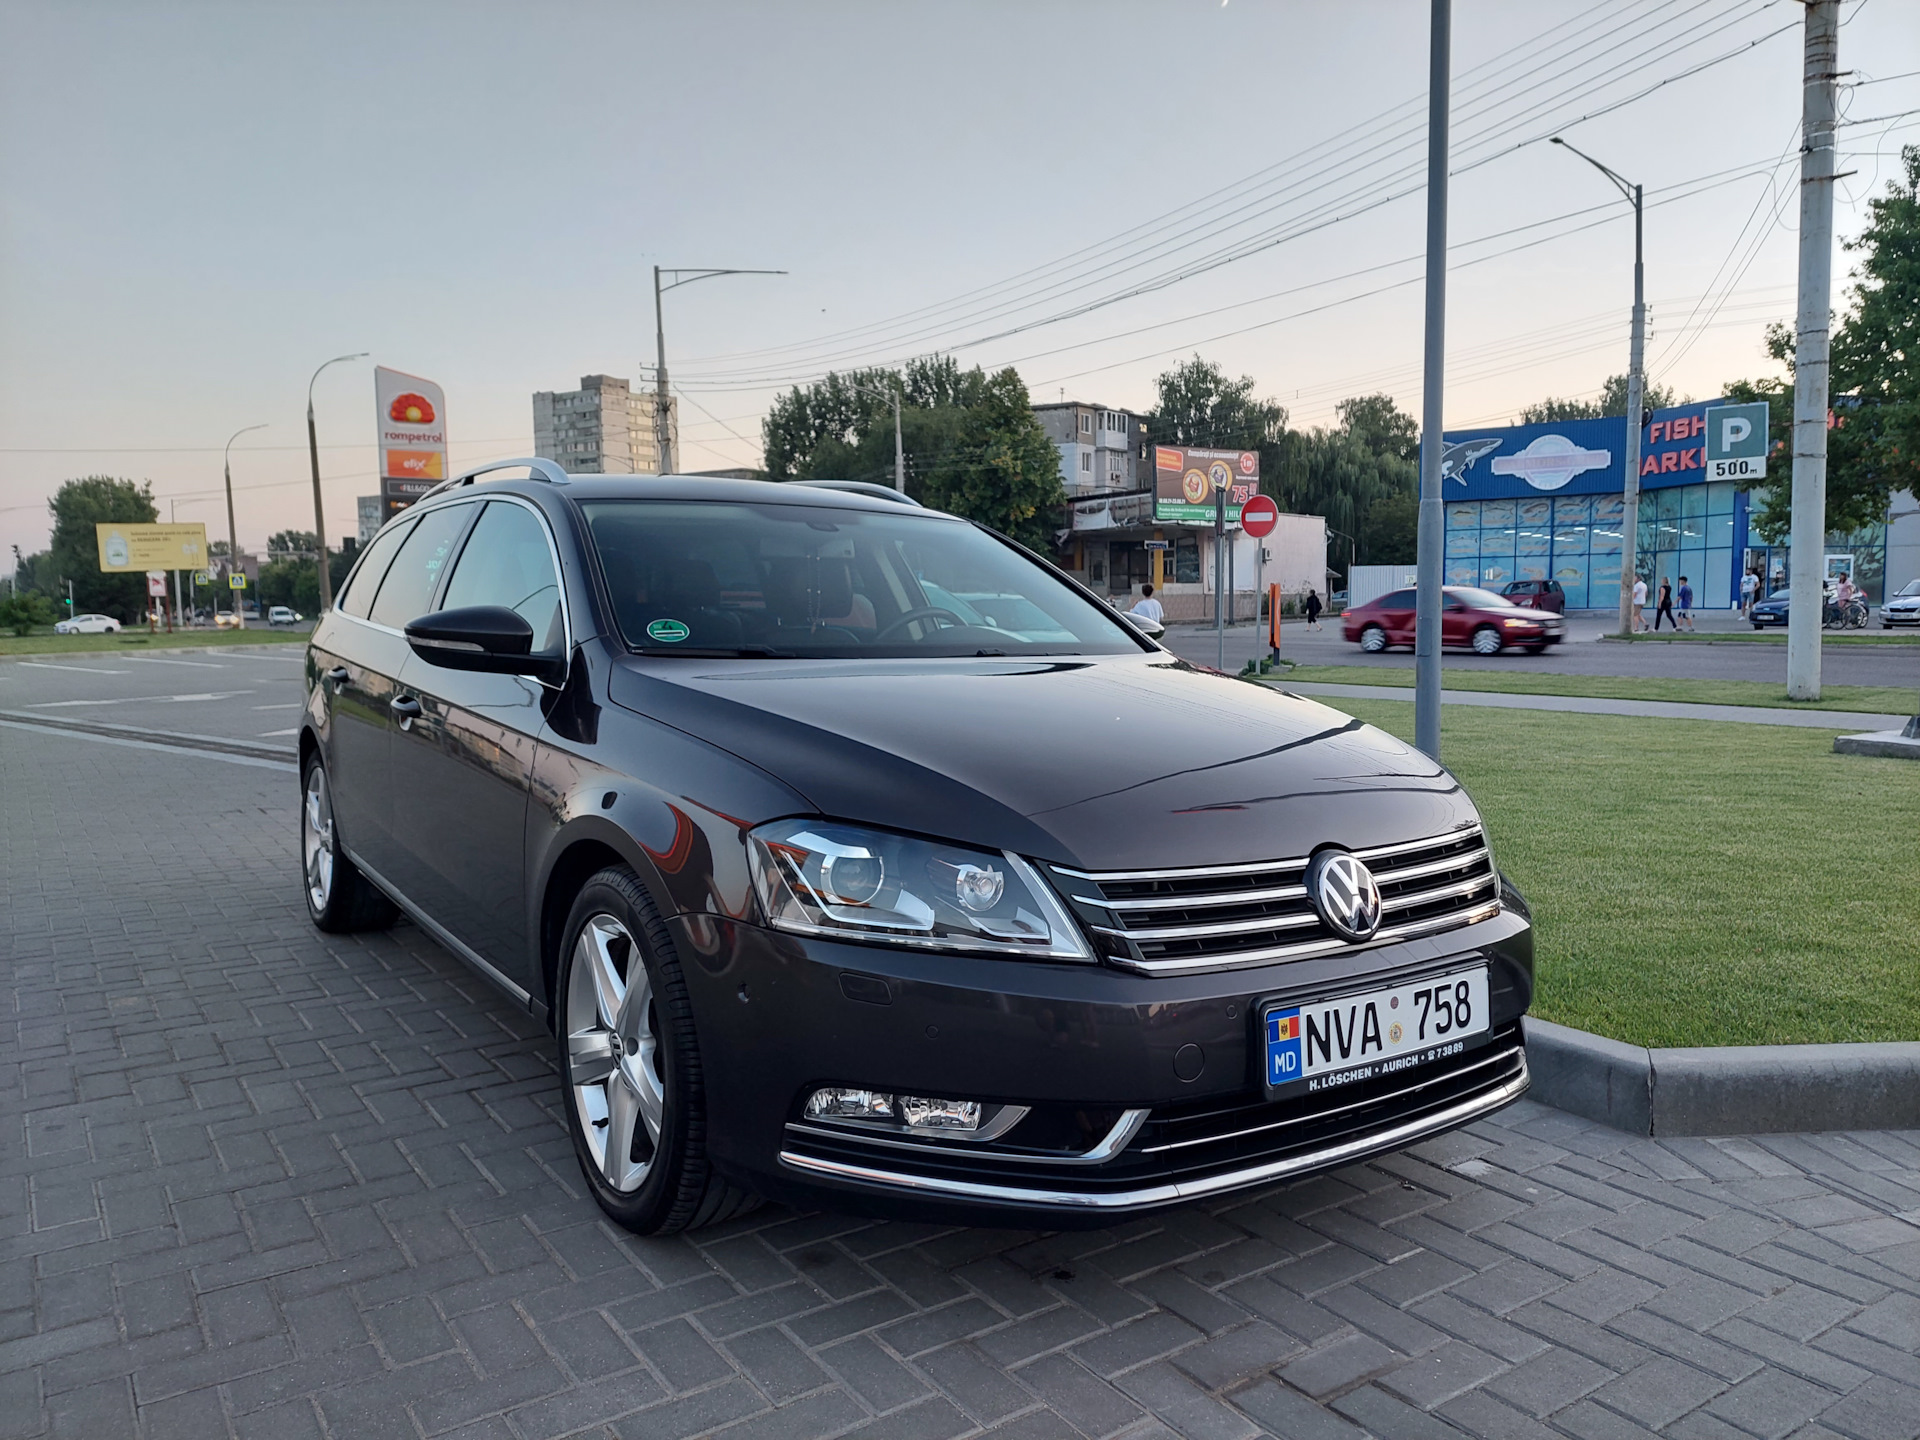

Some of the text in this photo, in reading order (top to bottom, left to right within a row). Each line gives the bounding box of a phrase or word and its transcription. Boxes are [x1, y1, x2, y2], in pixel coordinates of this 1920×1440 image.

[385, 432, 442, 444] rompetrol
[1650, 415, 1706, 444] FISH
[1721, 417, 1752, 452] P
[1639, 447, 1706, 476] ARK
[1231, 485, 1248, 503] 75
[1228, 510, 1242, 518] HIL
[1414, 980, 1471, 1040] 758
[1306, 1001, 1383, 1067] NVA
[1275, 1050, 1297, 1075] MD
[1382, 1054, 1419, 1074] AURICH
[1436, 1041, 1464, 1058] 73889
